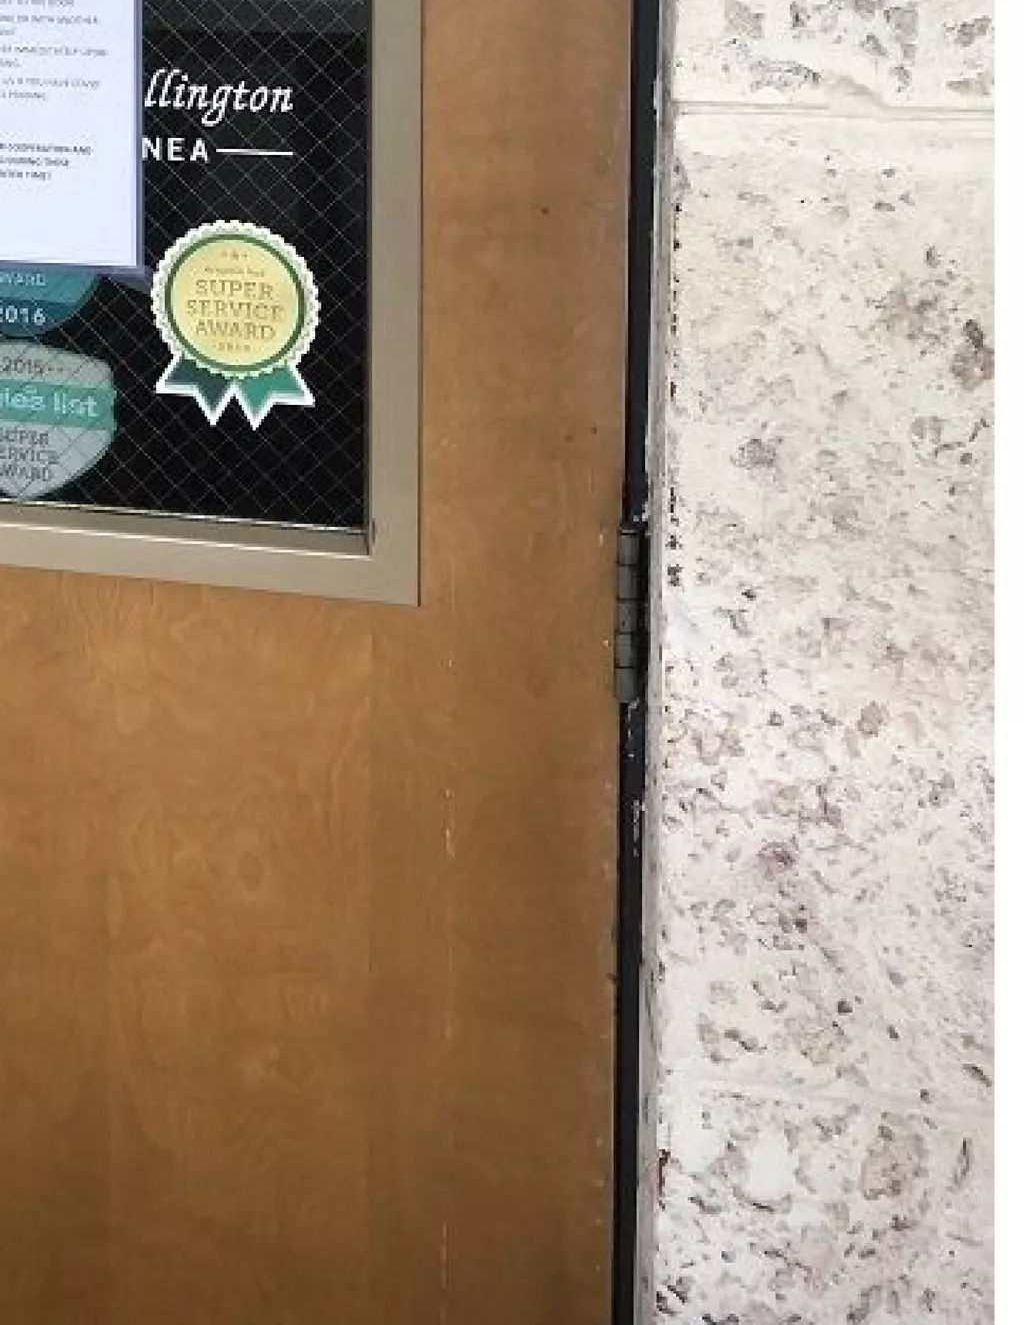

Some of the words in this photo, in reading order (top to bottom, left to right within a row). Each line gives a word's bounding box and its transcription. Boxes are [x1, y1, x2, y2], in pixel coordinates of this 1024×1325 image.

[144, 68, 294, 127] llington
[142, 137, 211, 163] NEA
[196, 279, 274, 301] SUPER
[186, 299, 285, 323] SERVICE
[195, 319, 276, 340] AWARD
[1, 356, 43, 375] 2015
[52, 391, 99, 418] list
